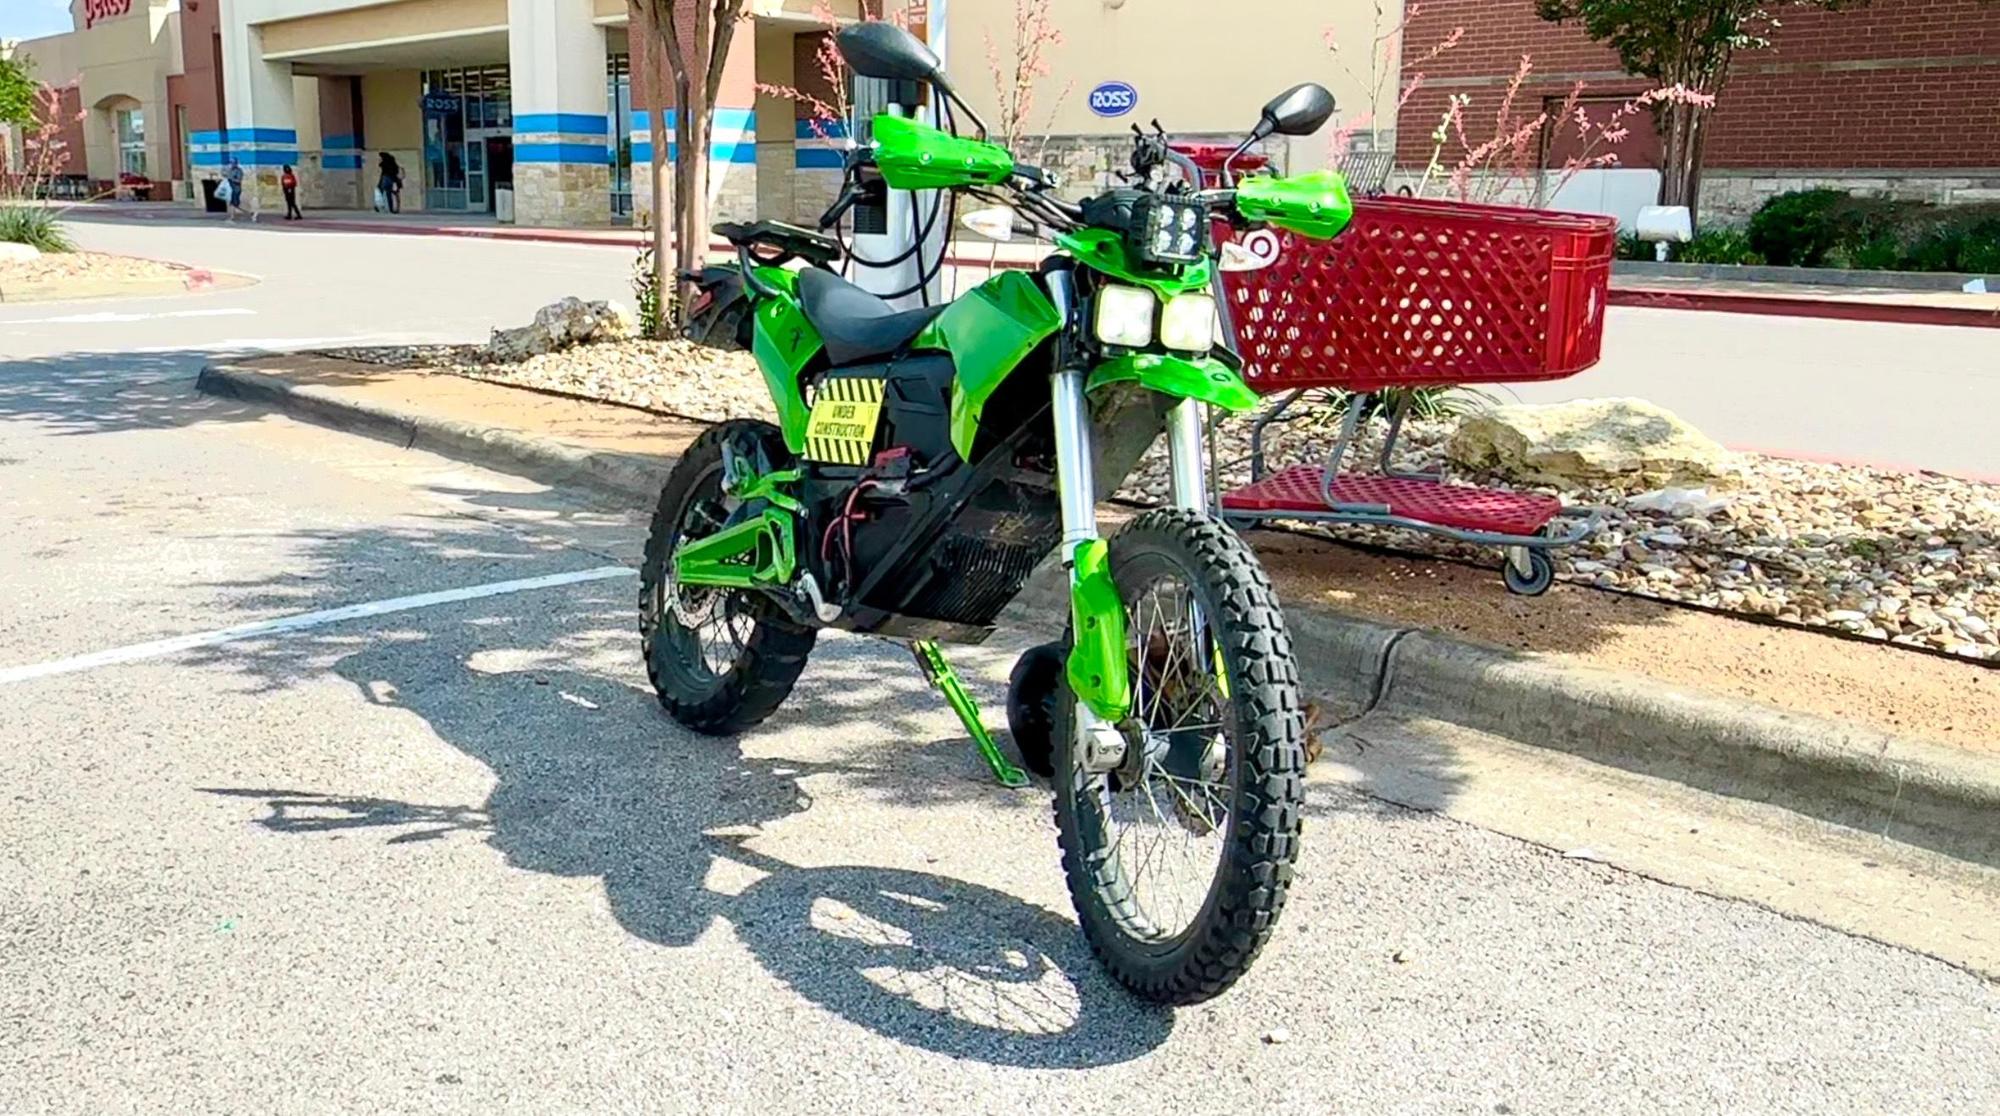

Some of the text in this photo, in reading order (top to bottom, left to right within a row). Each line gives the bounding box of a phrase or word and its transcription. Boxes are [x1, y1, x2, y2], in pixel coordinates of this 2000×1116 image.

[426, 98, 459, 110] ROSS
[1093, 91, 1131, 107] ROSS
[832, 405, 856, 419] UNDER
[814, 421, 866, 438] CONSTRUCTION
